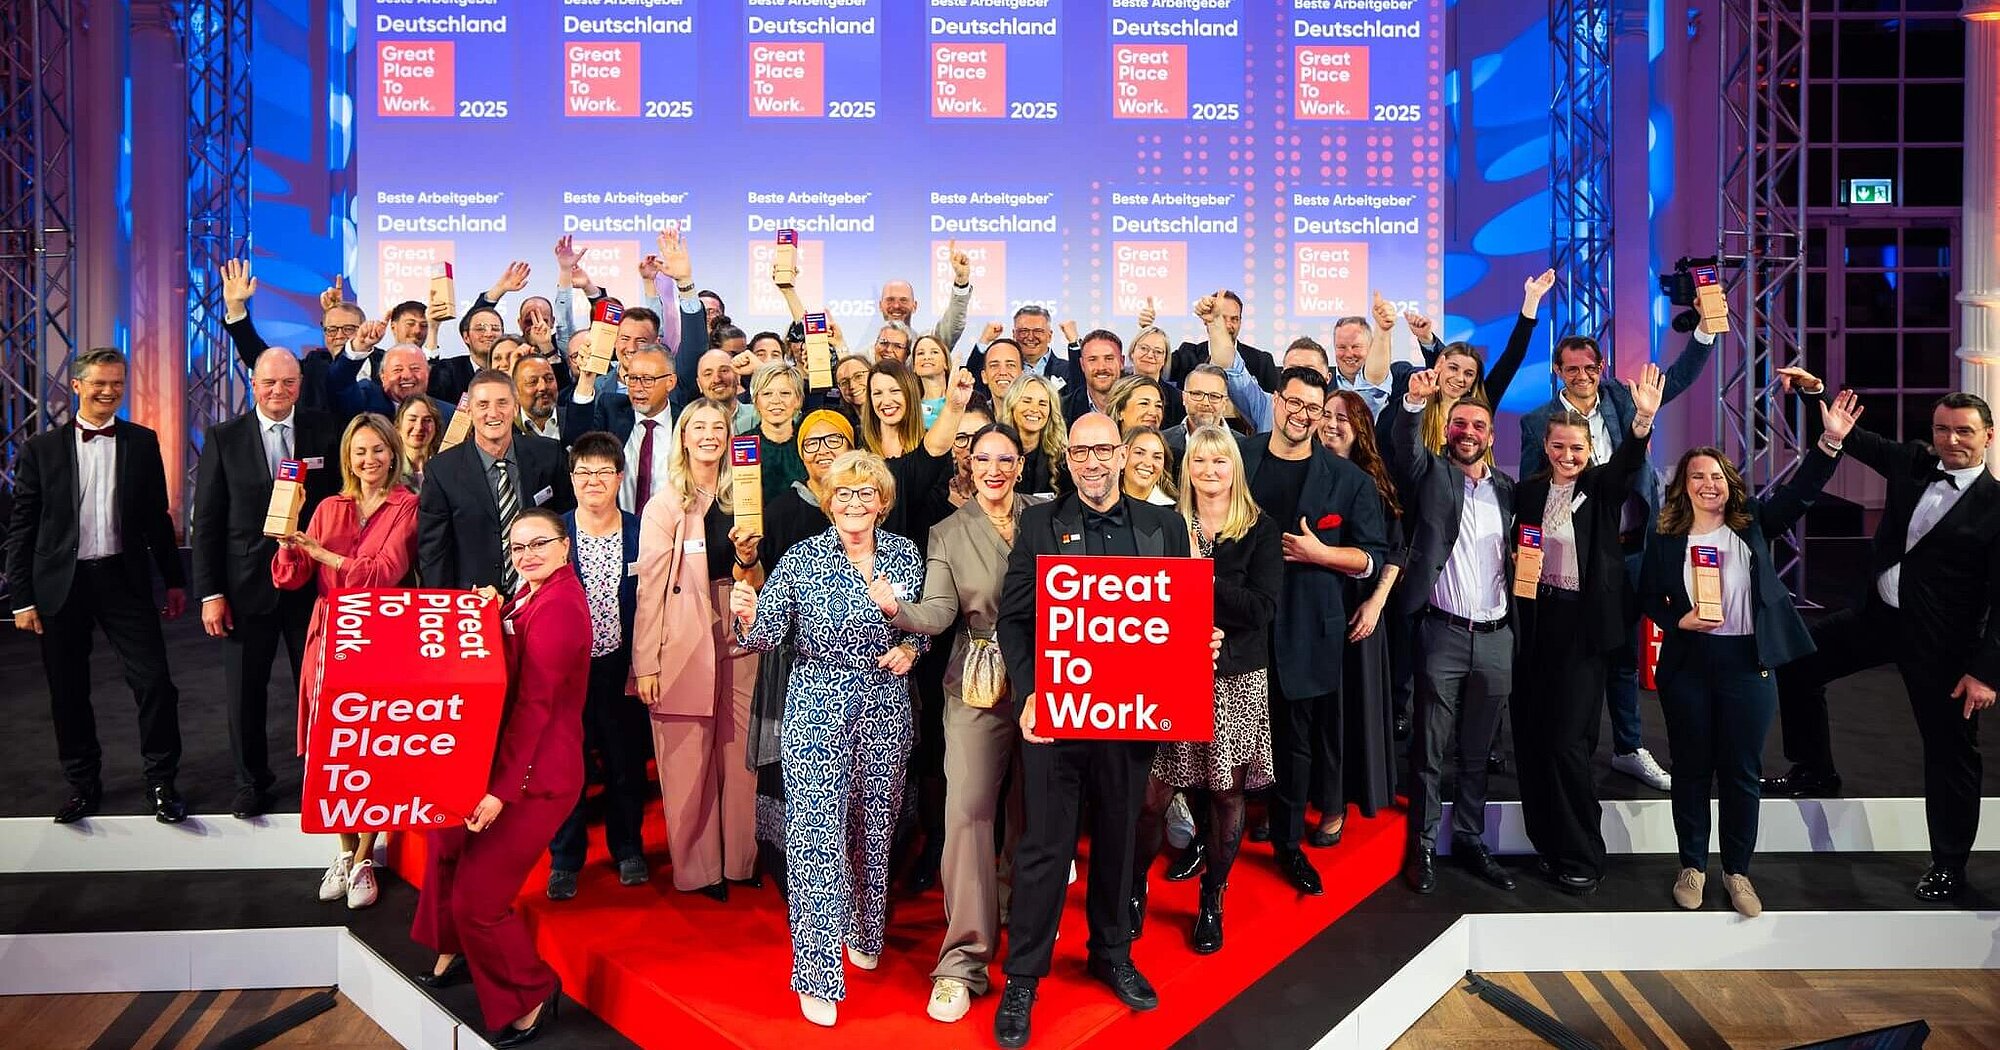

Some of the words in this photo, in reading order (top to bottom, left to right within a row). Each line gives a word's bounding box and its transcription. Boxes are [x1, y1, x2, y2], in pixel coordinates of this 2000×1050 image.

[1295, 0, 1330, 9] Beste
[377, 15, 506, 32] Deutschland
[564, 16, 691, 33] Deutschland
[749, 16, 874, 34] Deutschland
[931, 17, 1056, 35] Deutschland
[1113, 19, 1238, 36] Deutschland
[1295, 20, 1420, 38] Deutschland
[382, 46, 435, 61] Great
[569, 47, 621, 62] Great
[754, 47, 805, 62] Great
[936, 48, 987, 63] Great
[1118, 49, 1168, 64] Great
[1299, 50, 1350, 65] Great
[384, 62, 434, 77] Place
[571, 63, 620, 78] Place
[755, 63, 805, 78] Place
[938, 64, 986, 79] Place
[1119, 65, 1168, 80] Place
[1301, 67, 1350, 82] Place
[383, 80, 403, 94] To
[570, 80, 589, 94] To
[754, 80, 773, 95] To
[936, 81, 956, 95] To
[1118, 82, 1138, 96] To
[1300, 84, 1319, 98] To
[460, 101, 508, 117] 2025
[646, 101, 693, 117] 2025
[829, 102, 875, 118] 2025
[1011, 102, 1057, 118] 2025
[1192, 104, 1239, 120] 2025
[1374, 105, 1420, 121] 2025
[378, 192, 414, 203] Beste
[564, 192, 601, 203] Beste
[748, 192, 784, 203] Beste
[931, 192, 967, 204] Beste
[1113, 193, 1148, 204] Beste
[1294, 194, 1329, 206] Beste
[378, 214, 506, 232] Deutschland
[564, 214, 691, 232] Deutschland
[748, 214, 874, 232] Deutschland
[931, 215, 1056, 232] Deutschland
[1113, 215, 1237, 233] Deutschland
[1294, 216, 1418, 234] Deutschland
[382, 245, 436, 260] Great
[753, 246, 804, 260] Grt
[936, 246, 987, 261] Gat
[1118, 246, 1168, 261] Great
[1298, 246, 1349, 262] Great
[1119, 262, 1168, 277] Place
[1300, 264, 1349, 278] Place
[1118, 279, 1138, 293] To
[1299, 280, 1318, 294] To
[828, 300, 876, 316] 2025
[1046, 564, 1171, 602] Great
[378, 592, 411, 617] To
[418, 593, 451, 659] Place
[456, 593, 490, 659] Great
[1049, 606, 1170, 644] Place
[1044, 650, 1093, 684] To
[332, 692, 464, 722] Great
[329, 728, 456, 758] Place
[323, 764, 371, 792] To
